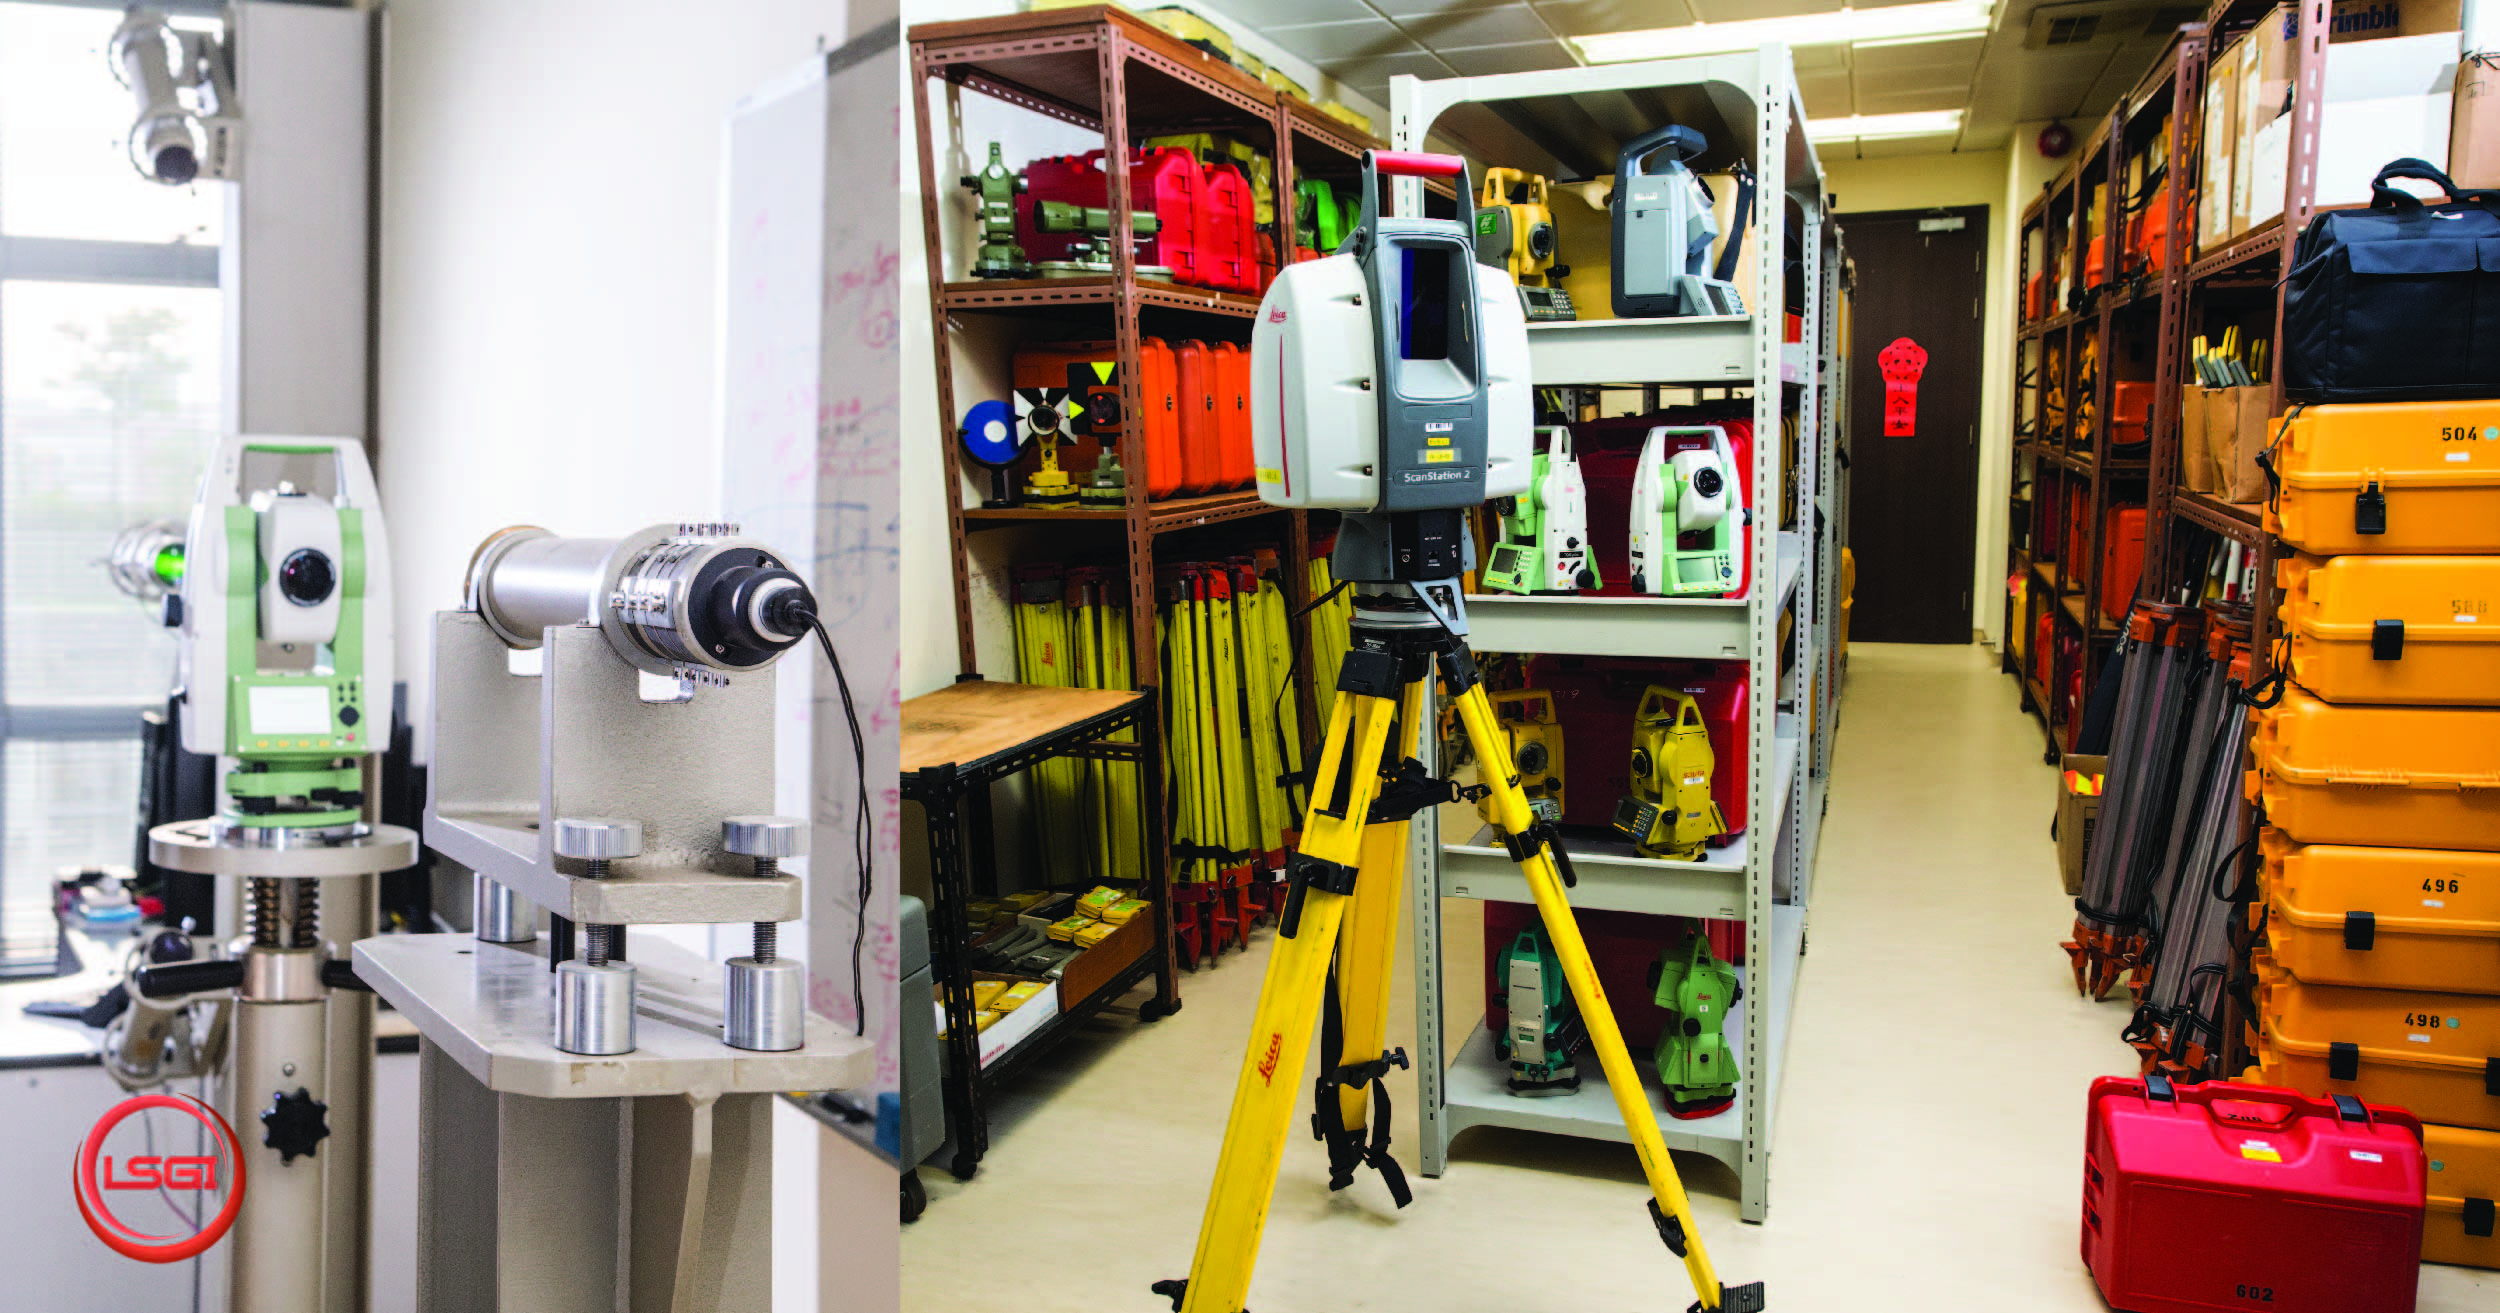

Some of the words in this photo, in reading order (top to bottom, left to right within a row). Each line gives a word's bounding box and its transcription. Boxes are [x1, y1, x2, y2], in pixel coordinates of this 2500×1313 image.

[2329, 4, 2400, 34] rimbl
[2442, 427, 2477, 441] 504
[1404, 471, 1462, 482] ScanStation
[1464, 470, 1470, 479] 2
[2422, 879, 2459, 893] 496
[2405, 1013, 2441, 1028] 498
[1257, 1032, 1282, 1088] Leica
[2236, 1284, 2274, 1302] 602
